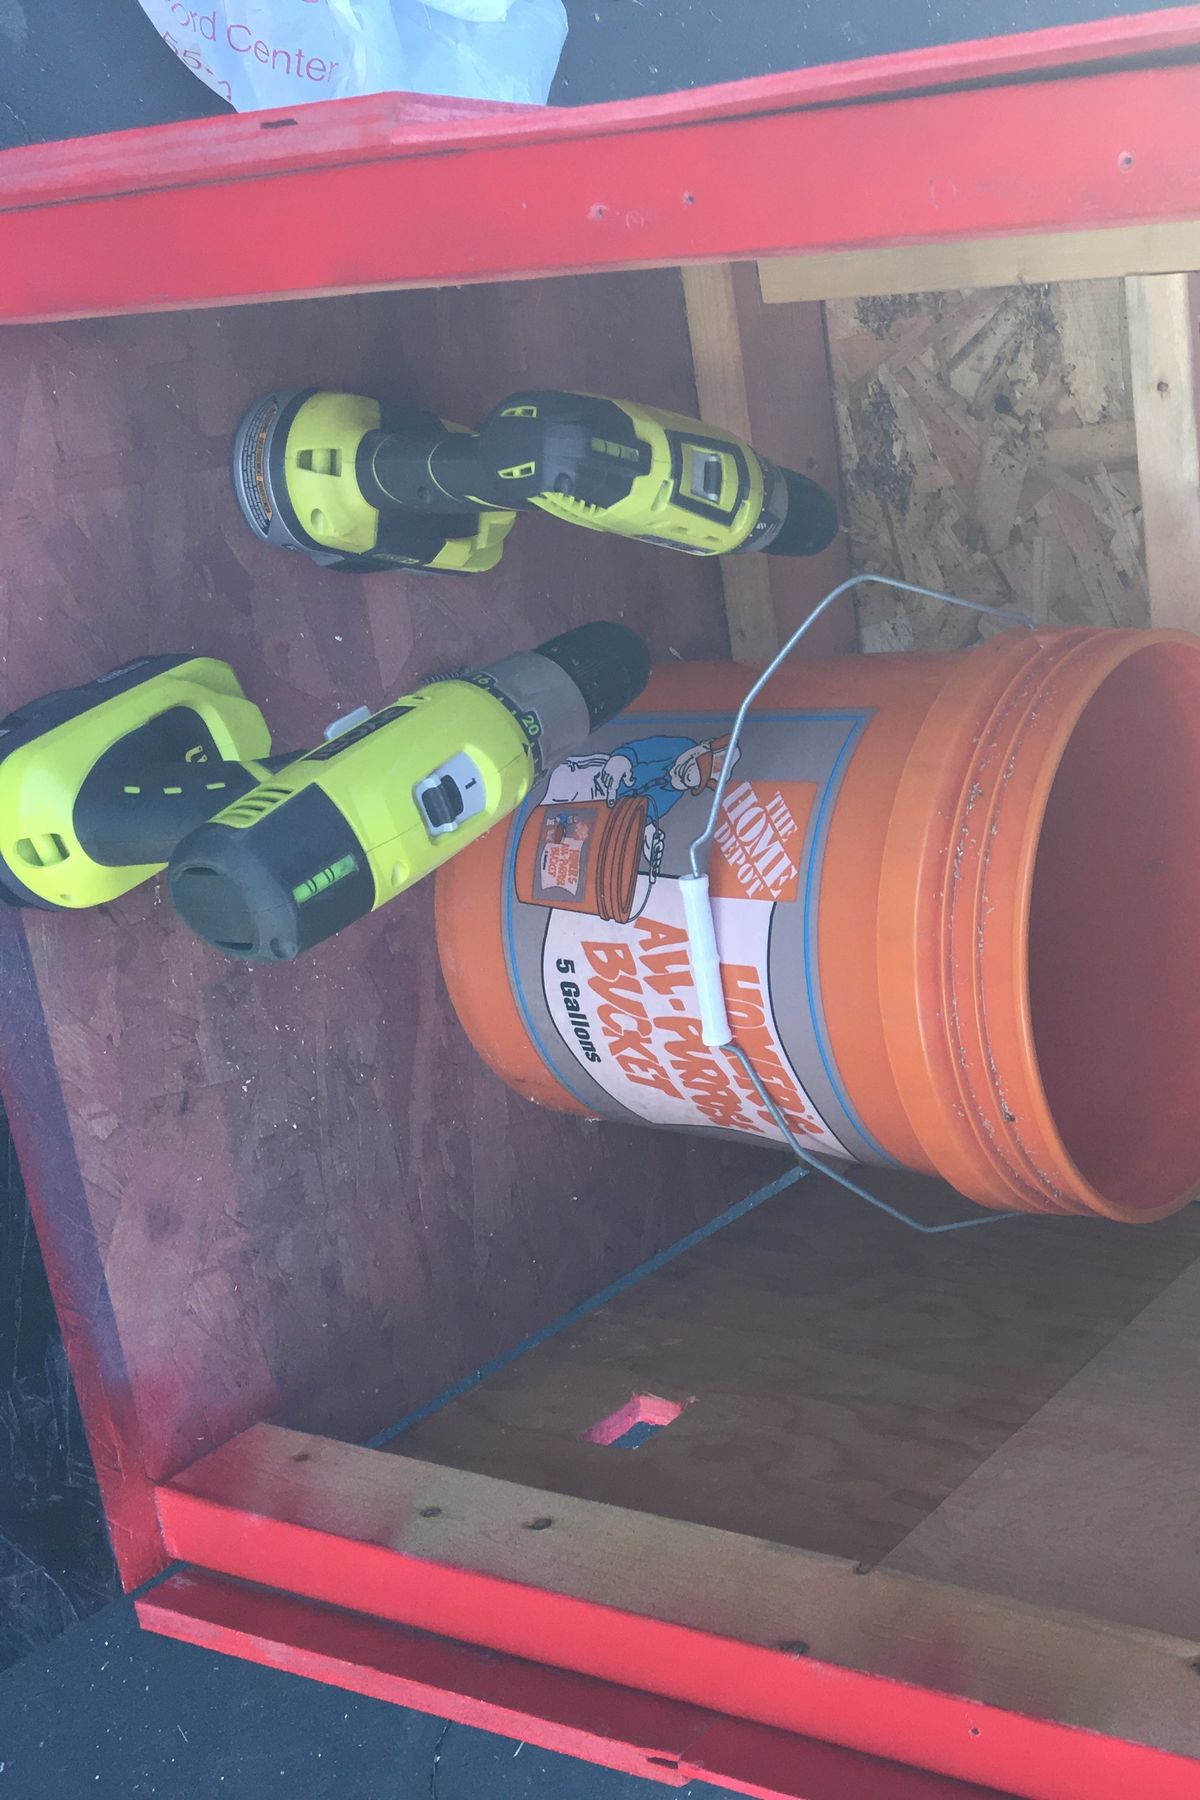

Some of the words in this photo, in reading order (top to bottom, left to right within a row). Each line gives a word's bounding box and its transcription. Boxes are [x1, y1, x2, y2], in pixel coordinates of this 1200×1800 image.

[226, 24, 340, 84] Center
[523, 715, 540, 736] 20
[465, 777, 477, 790] 1
[723, 782, 798, 899] HOME
[764, 789, 799, 843] THE
[713, 822, 766, 897] DEPOT
[556, 958, 576, 974] 5
[559, 980, 602, 1063] Gallons
[580, 940, 685, 1101] BUCKET
